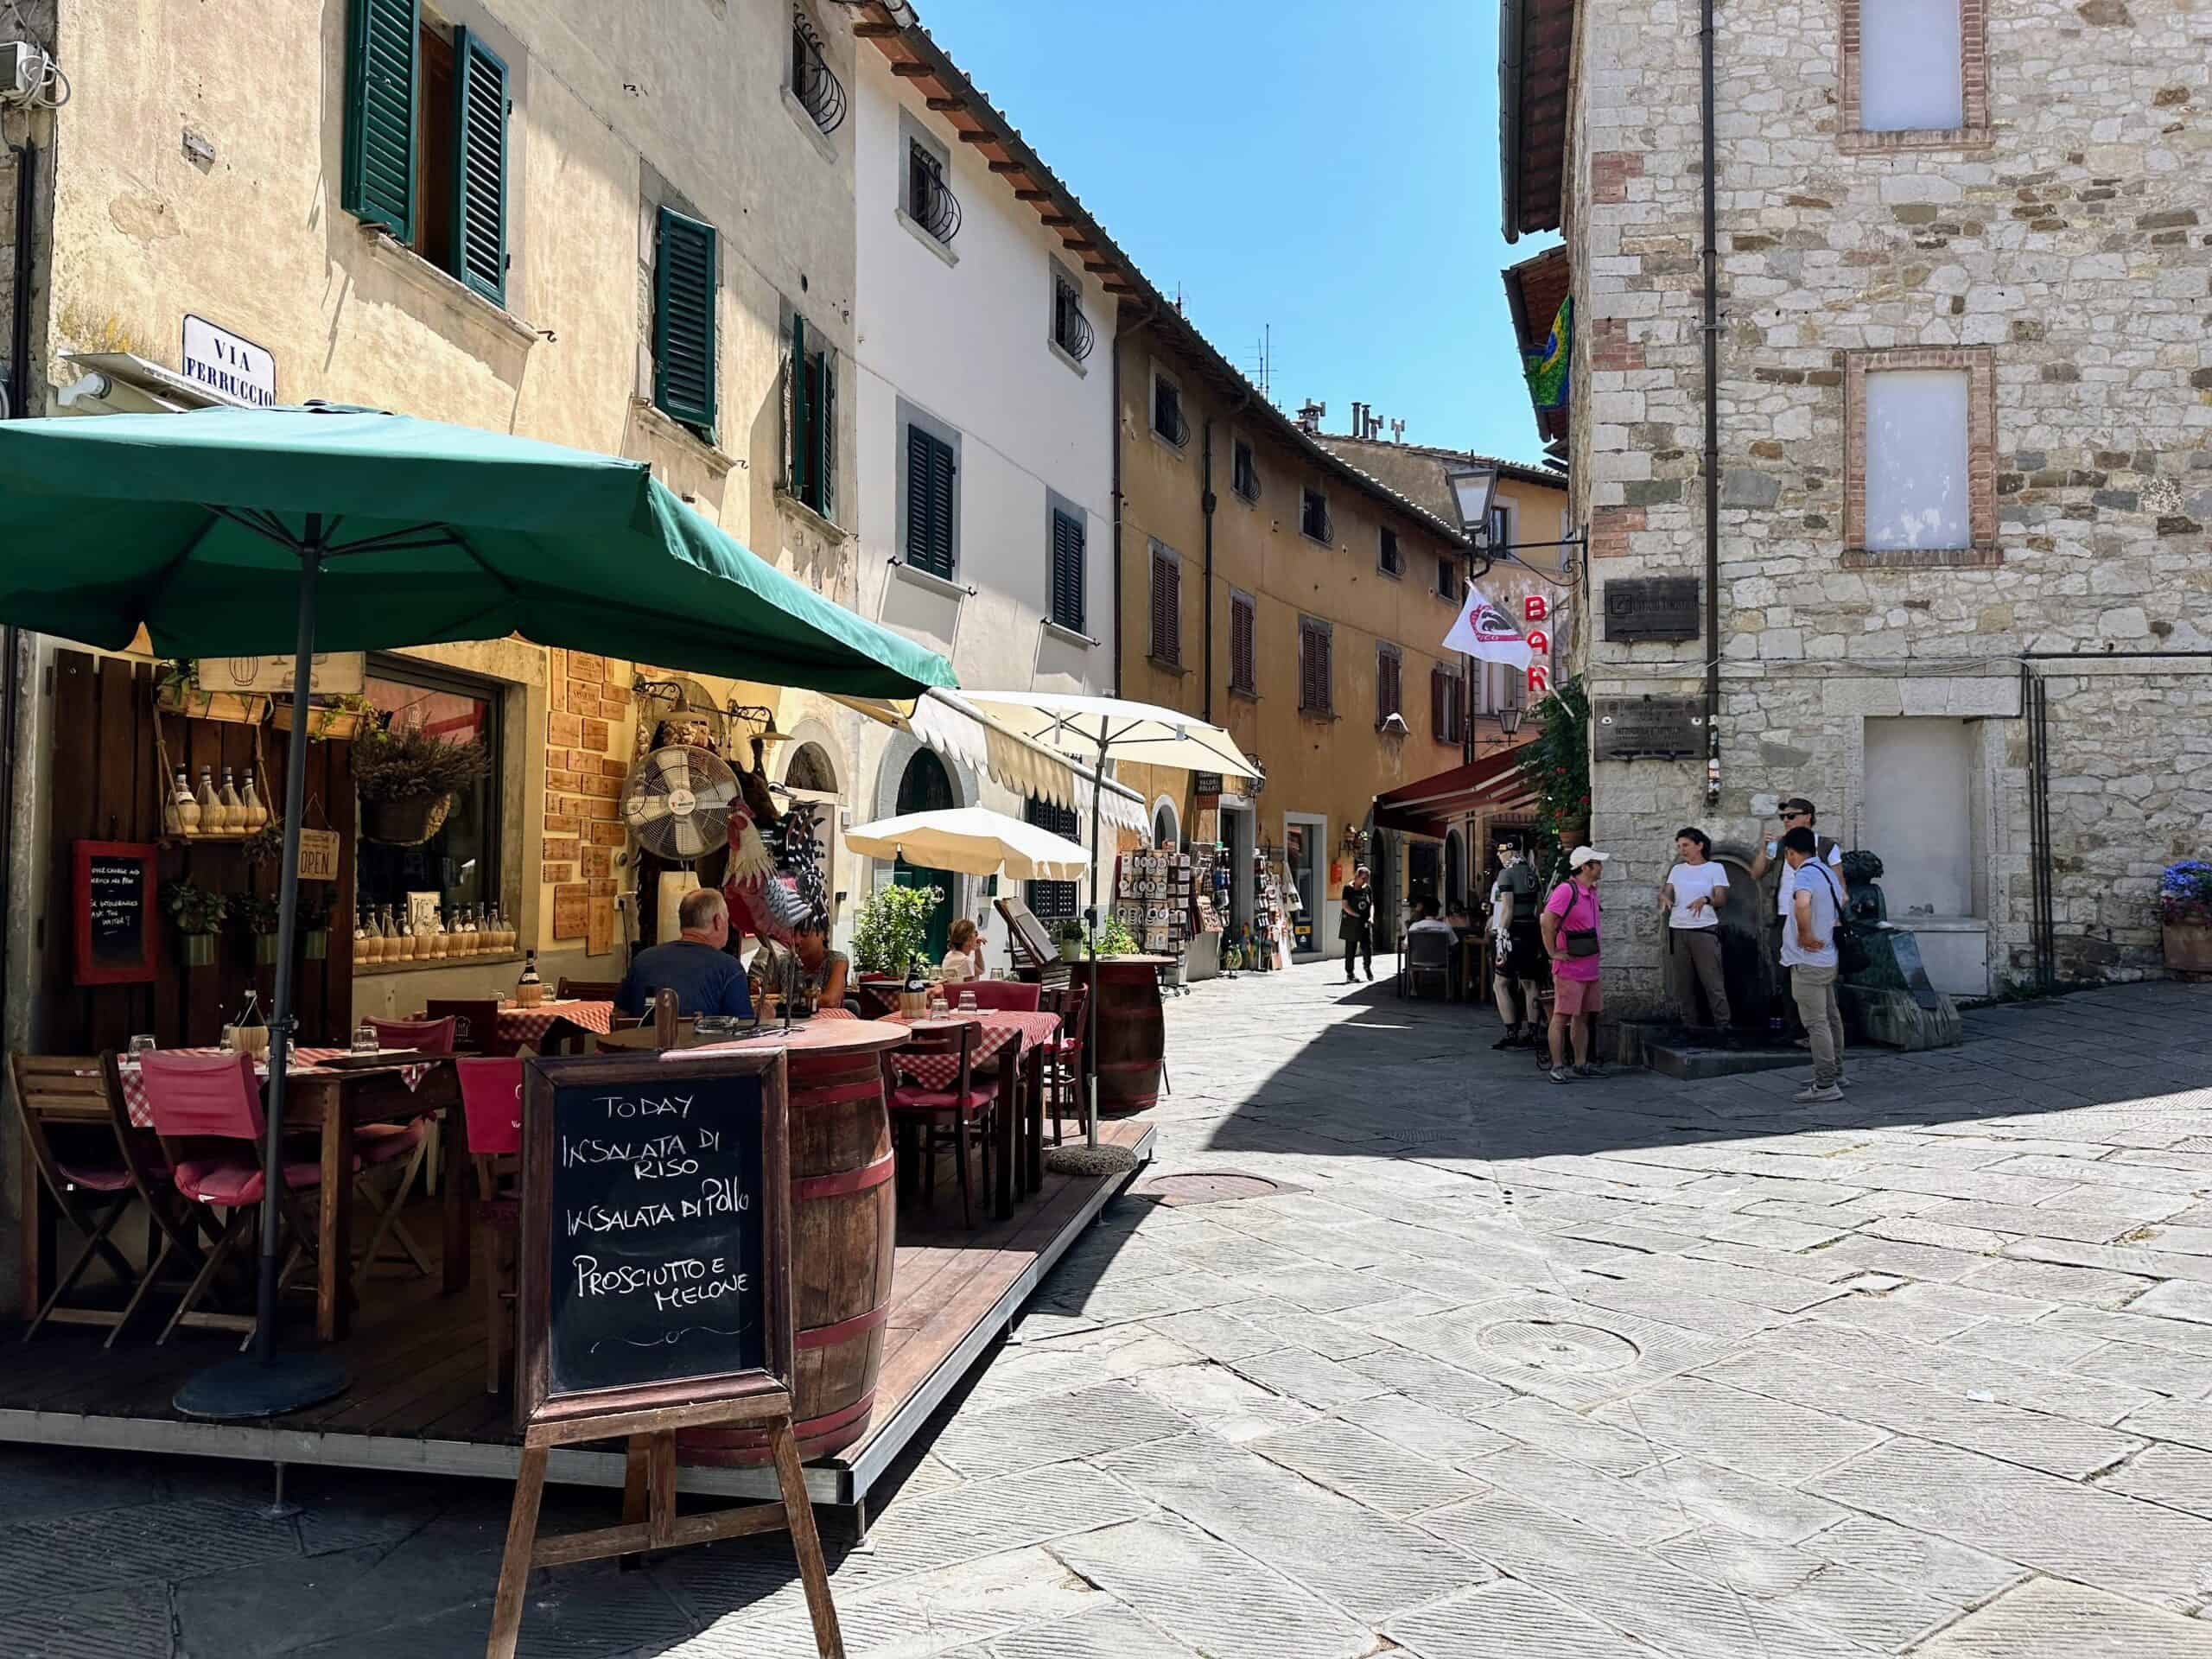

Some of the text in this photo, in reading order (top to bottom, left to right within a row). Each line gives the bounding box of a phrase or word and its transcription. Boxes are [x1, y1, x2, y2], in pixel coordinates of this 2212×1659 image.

[213, 338, 251, 372] VIA
[186, 356, 273, 407] FERRUCCIO
[1524, 594, 1549, 692] BAR
[301, 850, 329, 875] OPEN
[592, 1095, 695, 1119] TODAY
[563, 1127, 720, 1168] INSALATA DI
[633, 1158, 699, 1180] RISO
[567, 1202, 676, 1236] INSALATA
[681, 1198, 702, 1217] DI
[572, 1254, 725, 1297] PROSCIUTTO E
[654, 1273, 750, 1312] MELONE
